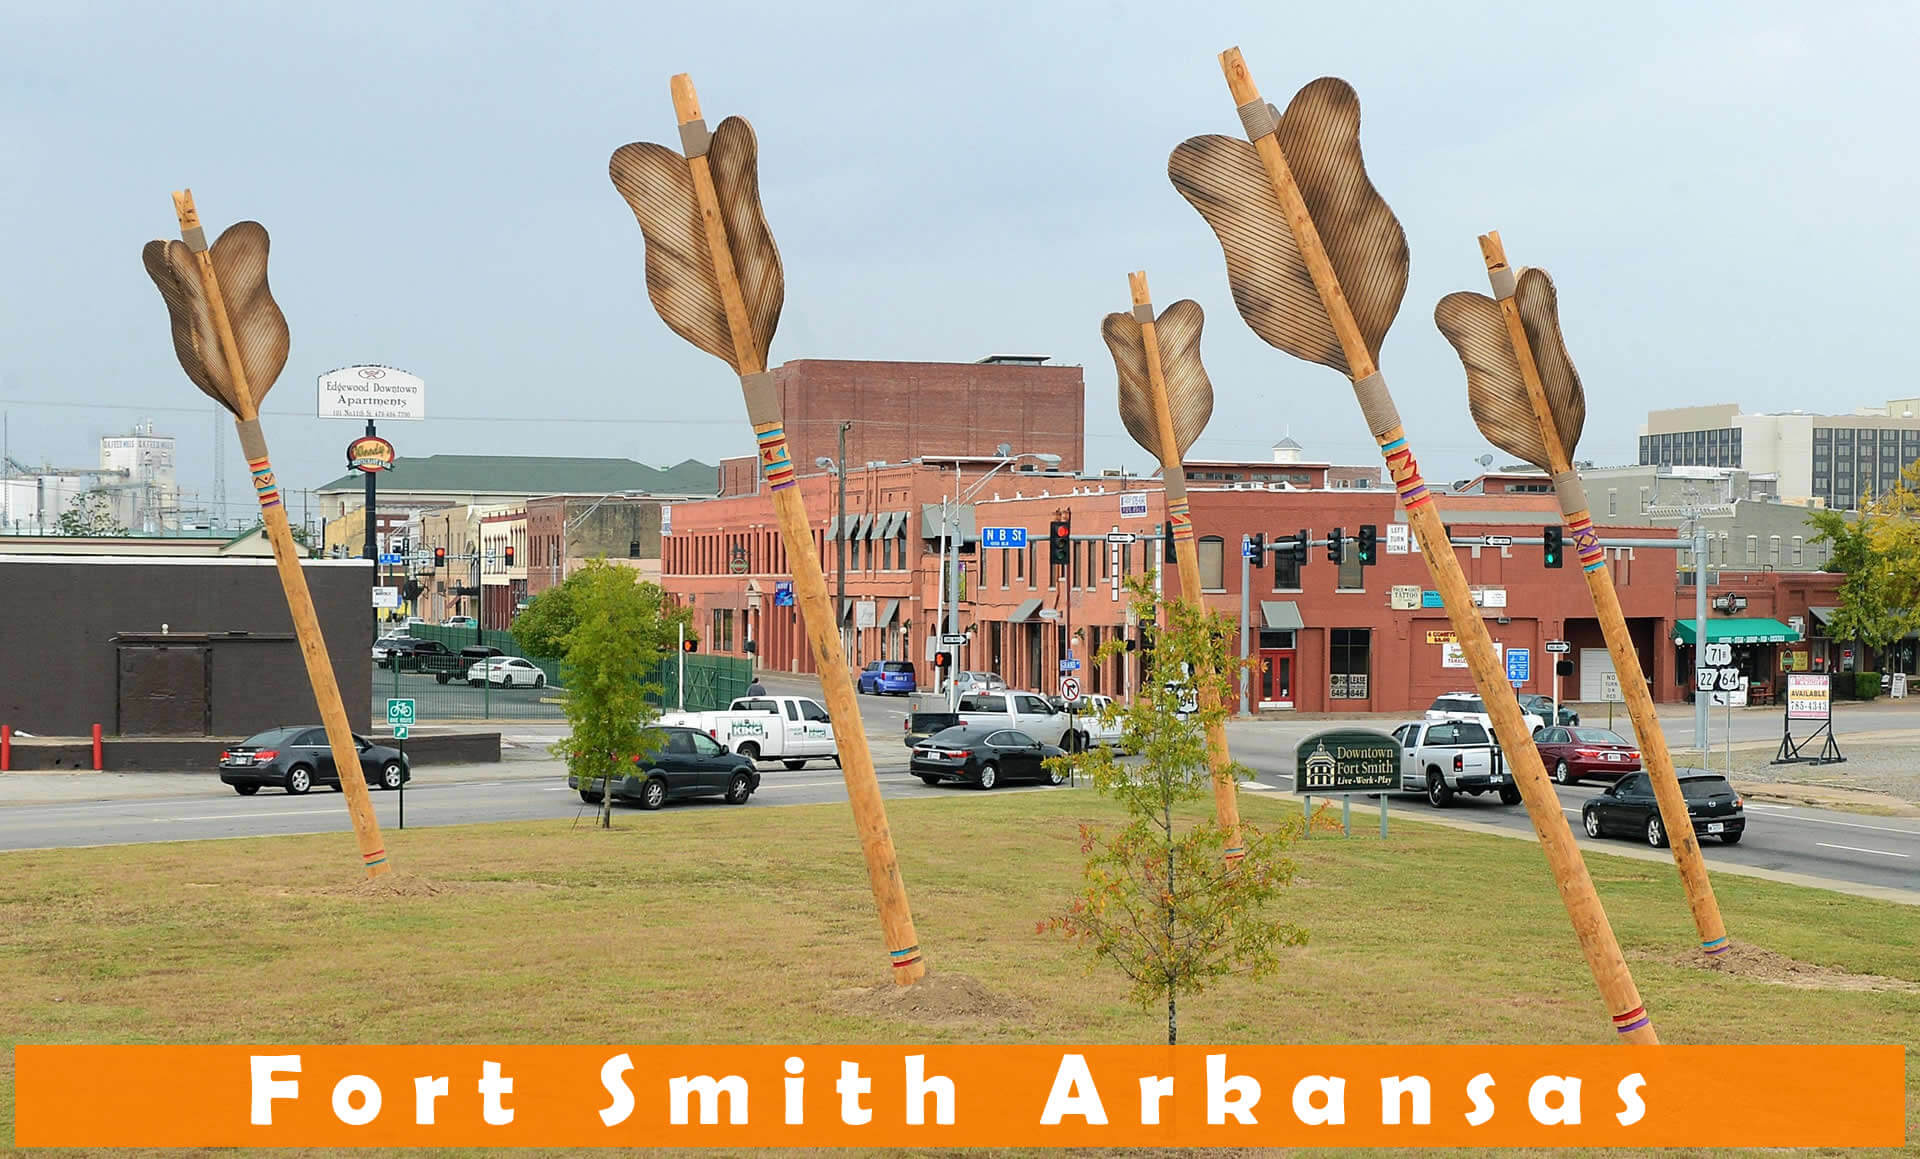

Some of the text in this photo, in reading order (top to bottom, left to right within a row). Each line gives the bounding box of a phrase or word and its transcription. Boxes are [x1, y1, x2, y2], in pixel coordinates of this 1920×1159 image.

[326, 381, 418, 394] Edgewood Downtown
[337, 395, 407, 408] Apartments
[986, 529, 1022, 541] N B St
[1711, 648, 1721, 661] 71
[1700, 672, 1712, 686] 22
[1722, 673, 1736, 686] 64
[1791, 689, 1826, 697] AVAILABLE
[733, 727, 762, 735] KING
[1337, 746, 1393, 759] Downtown
[1337, 760, 1393, 774] Fort Smith
